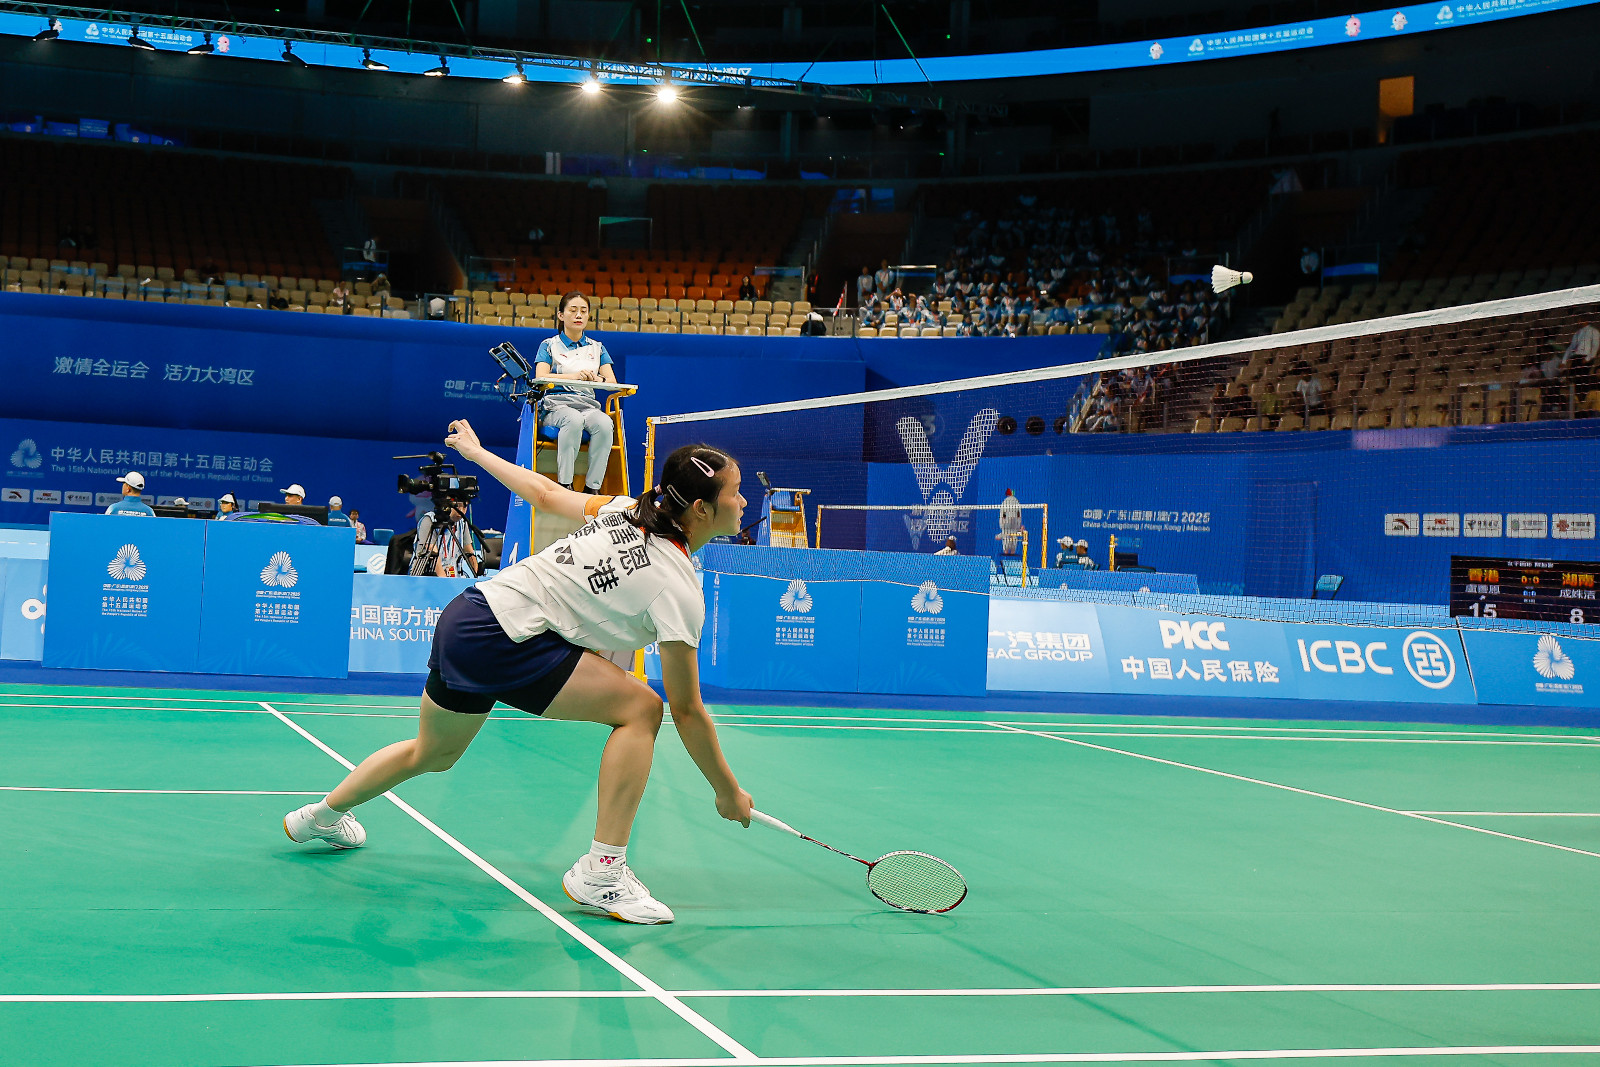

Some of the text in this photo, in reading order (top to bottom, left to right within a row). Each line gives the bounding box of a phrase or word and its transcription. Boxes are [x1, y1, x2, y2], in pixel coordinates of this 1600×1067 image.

[53, 357, 255, 386] 激情全运会 活力大湾区
[51, 446, 274, 472] 中华人民共和国第十五届运动会
[52, 464, 274, 483] The 15th National Ges of the People's Republic of China
[1181, 511, 1211, 524] 2025
[1468, 602, 1498, 619] 15
[1570, 608, 1584, 624] 8
[350, 627, 385, 641] HINA
[1158, 619, 1231, 651] PICC
[1024, 649, 1094, 662] GROUP
[1297, 638, 1394, 675] ICBC
[1121, 655, 1280, 683] 中国人民保险
